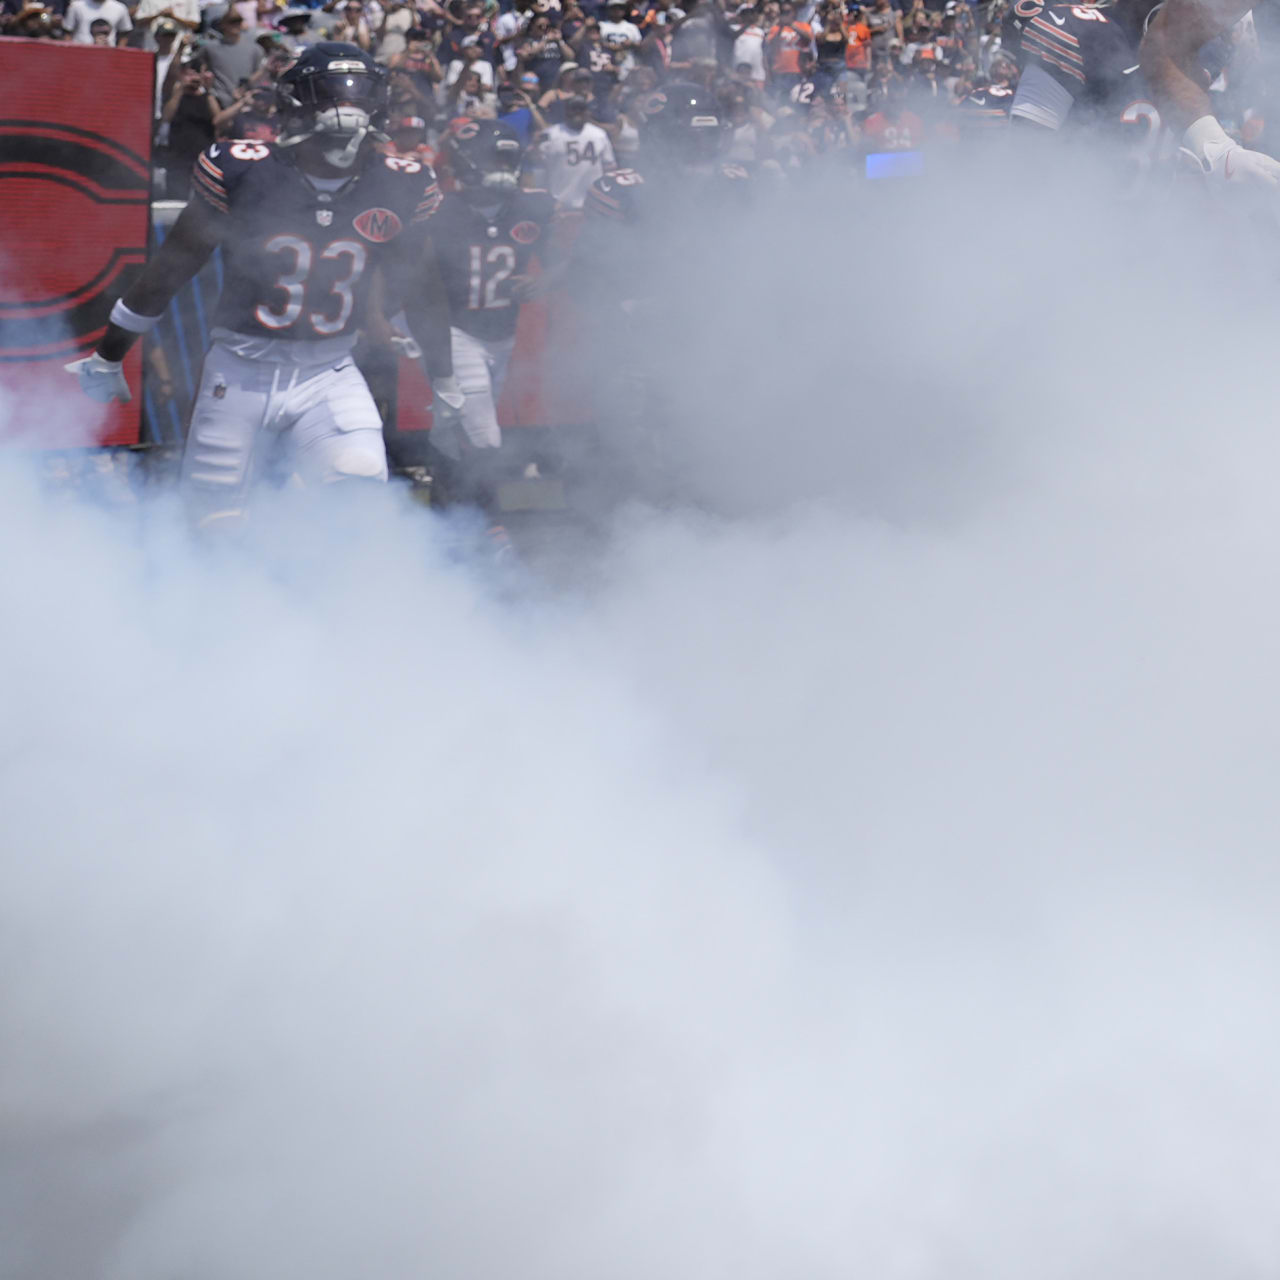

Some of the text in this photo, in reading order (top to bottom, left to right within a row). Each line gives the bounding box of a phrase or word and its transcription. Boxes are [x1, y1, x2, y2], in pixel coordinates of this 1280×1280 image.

[565, 139, 598, 166] 54
[255, 233, 366, 335] 33
[467, 244, 517, 310] 12
